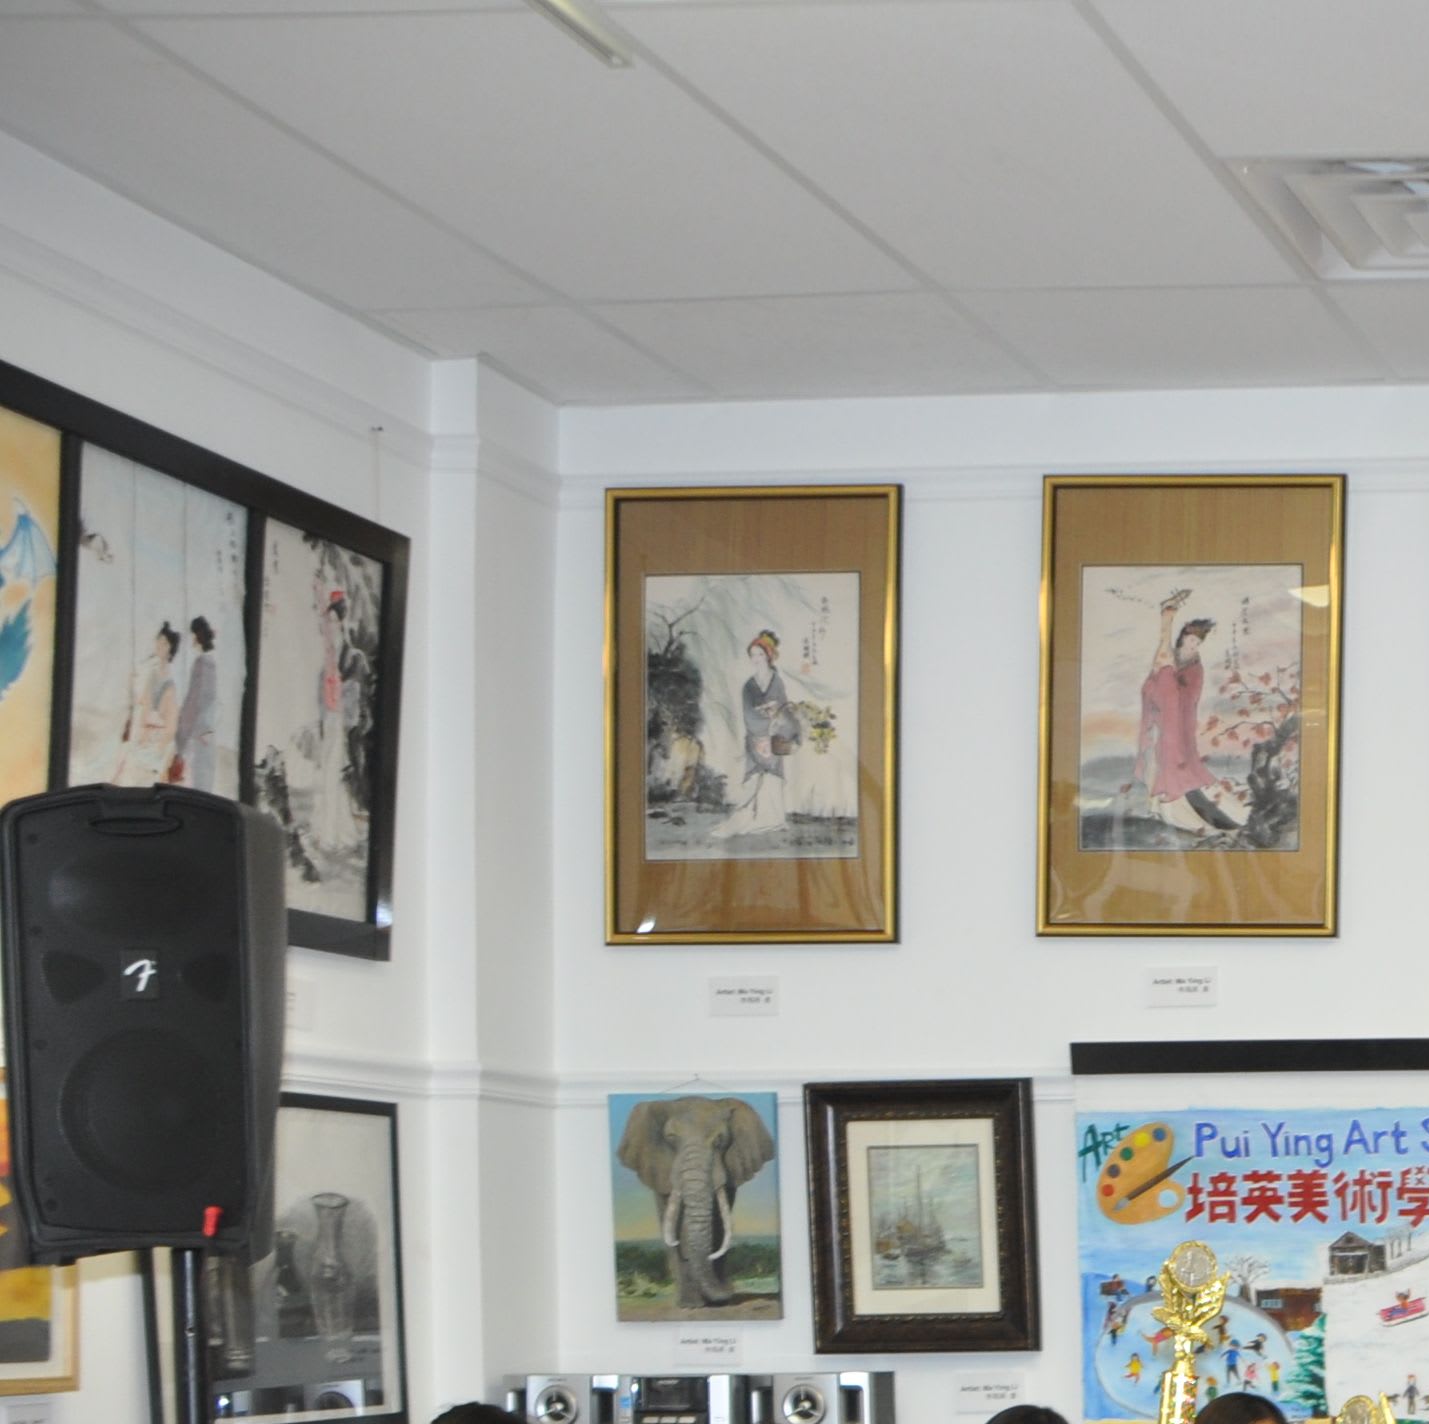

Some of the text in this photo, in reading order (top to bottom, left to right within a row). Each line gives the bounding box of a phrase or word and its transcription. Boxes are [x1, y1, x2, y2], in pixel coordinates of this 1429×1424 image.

[1195, 1122, 1250, 1158] Pui
[1261, 1121, 1334, 1168] Ying
[1343, 1118, 1408, 1155] Art
